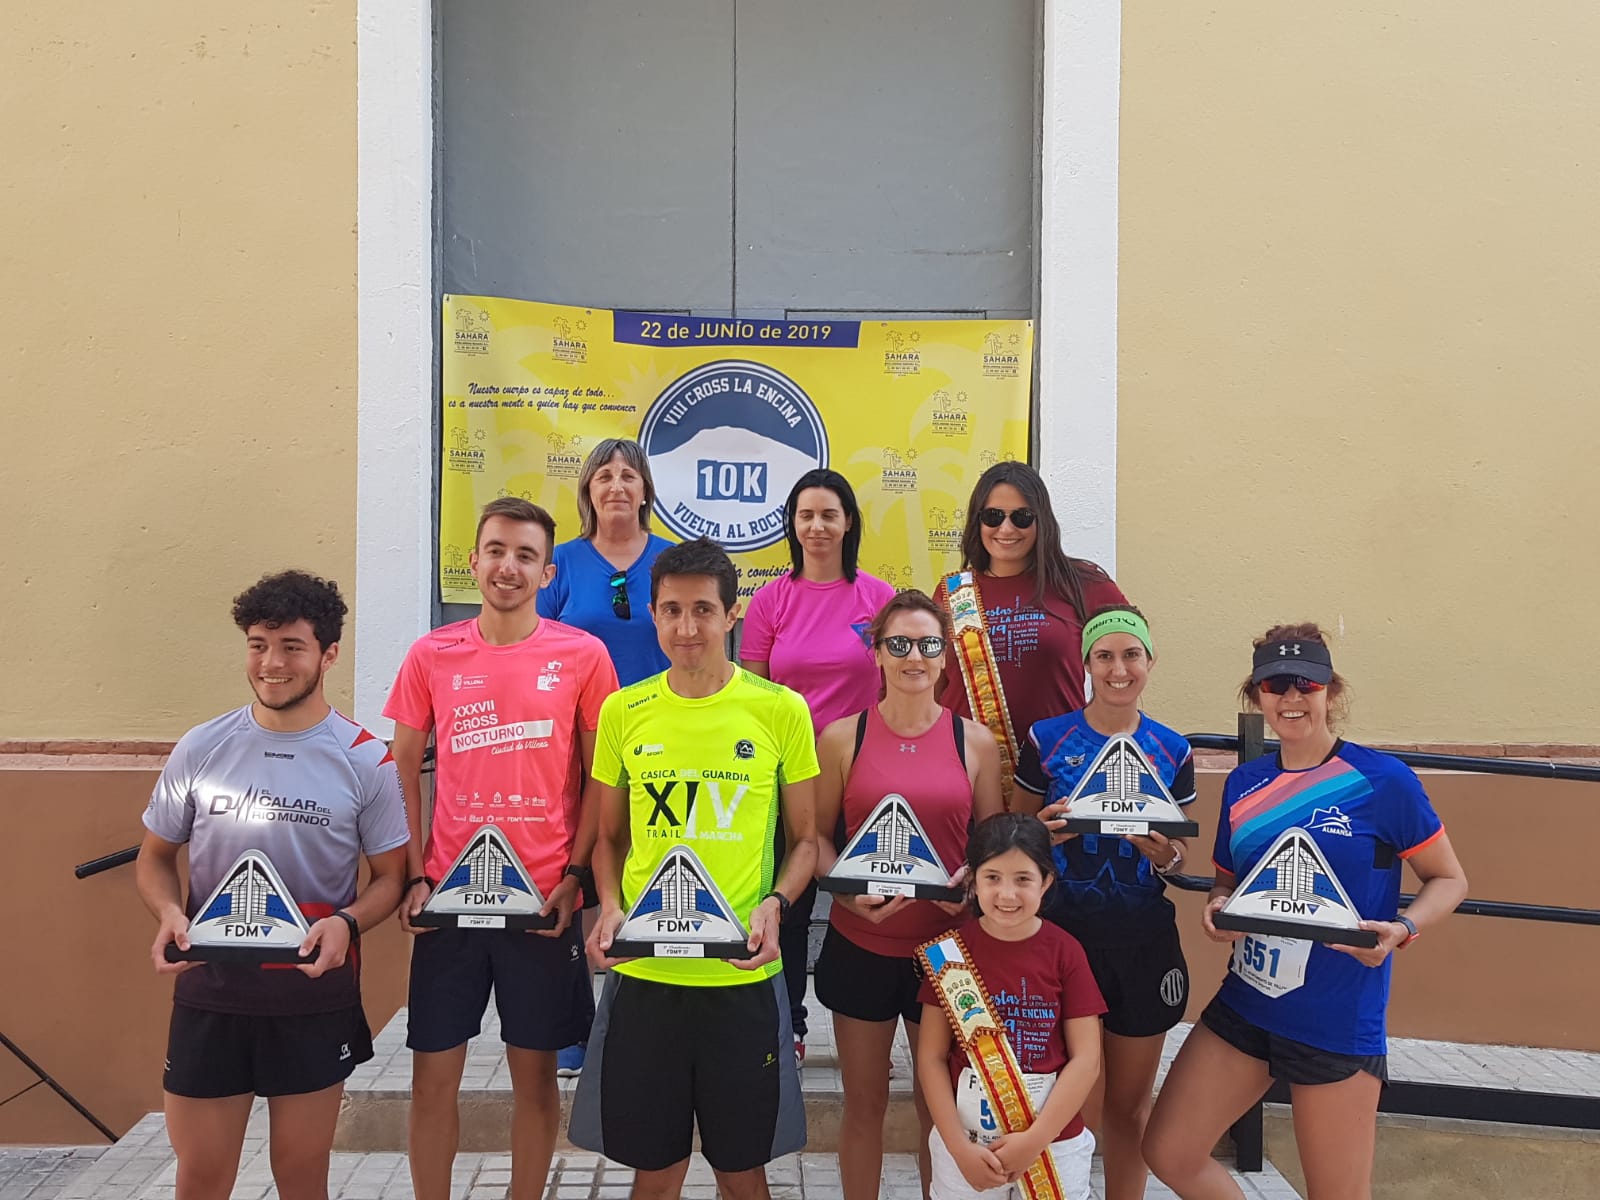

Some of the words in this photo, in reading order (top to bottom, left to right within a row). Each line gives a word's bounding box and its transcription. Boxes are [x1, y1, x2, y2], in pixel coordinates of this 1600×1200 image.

[455, 331, 489, 341] SAHARA
[641, 321, 661, 339] 22
[667, 322, 689, 340] de
[760, 323, 781, 340] de
[788, 324, 831, 341] 2019
[553, 338, 588, 350] SAHARA
[885, 352, 920, 362] SAHARA
[983, 354, 1019, 363] SAHARA
[468, 382, 500, 396] Nuestro
[502, 386, 530, 398] cuerpo
[532, 387, 542, 395] es
[544, 387, 570, 401] capaz
[573, 386, 583, 397] de
[448, 399, 458, 408] es
[468, 398, 499, 409] nuestra
[501, 399, 525, 409] mente
[536, 399, 560, 412] quien
[562, 398, 579, 413] hay
[582, 401, 597, 414] que
[599, 402, 637, 414] convencer
[663, 400, 689, 426] VIII
[684, 377, 731, 406] CROSS
[734, 377, 753, 395] LA
[755, 382, 803, 429] ENCINA
[931, 412, 968, 422] SAHARA
[449, 449, 485, 459] SAHARA
[547, 454, 582, 465] SAHARA
[699, 463, 764, 498] 10K
[882, 470, 918, 479] SAHARA
[673, 500, 722, 538] VUELTA
[726, 523, 746, 539] AL
[443, 567, 472, 576] SAHAR
[453, 699, 496, 719] XXXVII
[454, 714, 499, 733] CROSS
[455, 725, 525, 749] NOCTURNO
[491, 741, 515, 756] Ciudad
[515, 740, 525, 752] de
[524, 737, 550, 751] Villena
[641, 769, 677, 781] CASICA
[702, 769, 751, 783] GUARDIA
[259, 796, 318, 812] CALAR
[317, 806, 333, 816] DEL
[642, 781, 750, 840] XIV
[1101, 800, 1134, 813] FDM
[278, 813, 330, 827] MUNDO
[647, 829, 682, 839] TRAIL
[1322, 825, 1353, 838] ALMANSA
[870, 861, 903, 875] FDM
[464, 893, 496, 906] FDM
[1270, 899, 1306, 915] FDM
[225, 924, 259, 937] FDM
[657, 919, 690, 933] FDM
[1243, 935, 1281, 979] 551
[946, 978, 972, 995] 2019
[1007, 1007, 1020, 1017] LA
[1022, 1008, 1056, 1019] ENCINA
